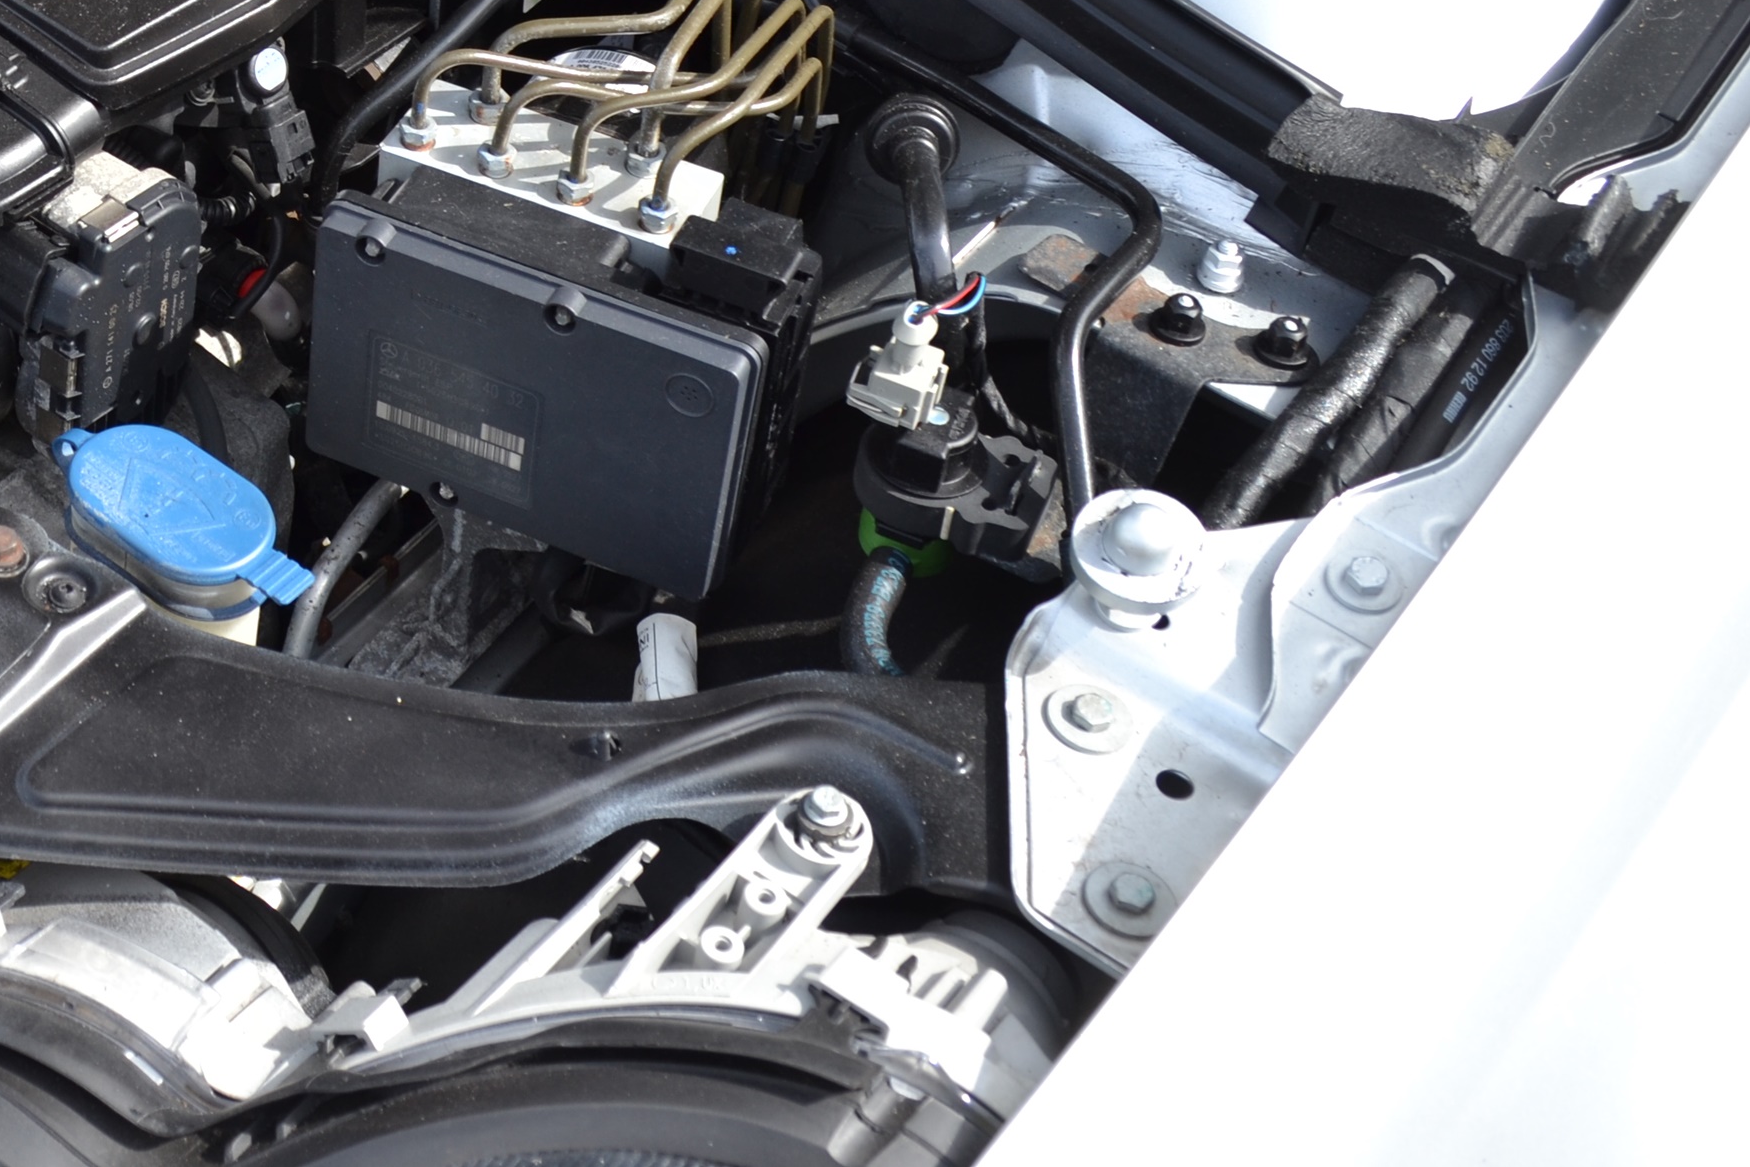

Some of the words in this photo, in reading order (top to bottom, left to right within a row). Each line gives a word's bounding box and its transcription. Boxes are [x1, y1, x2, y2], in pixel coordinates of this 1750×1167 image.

[1481, 337, 1501, 362] 860
[1470, 357, 1488, 377] 12
[1460, 371, 1479, 392] 92
[509, 393, 524, 409] 32
